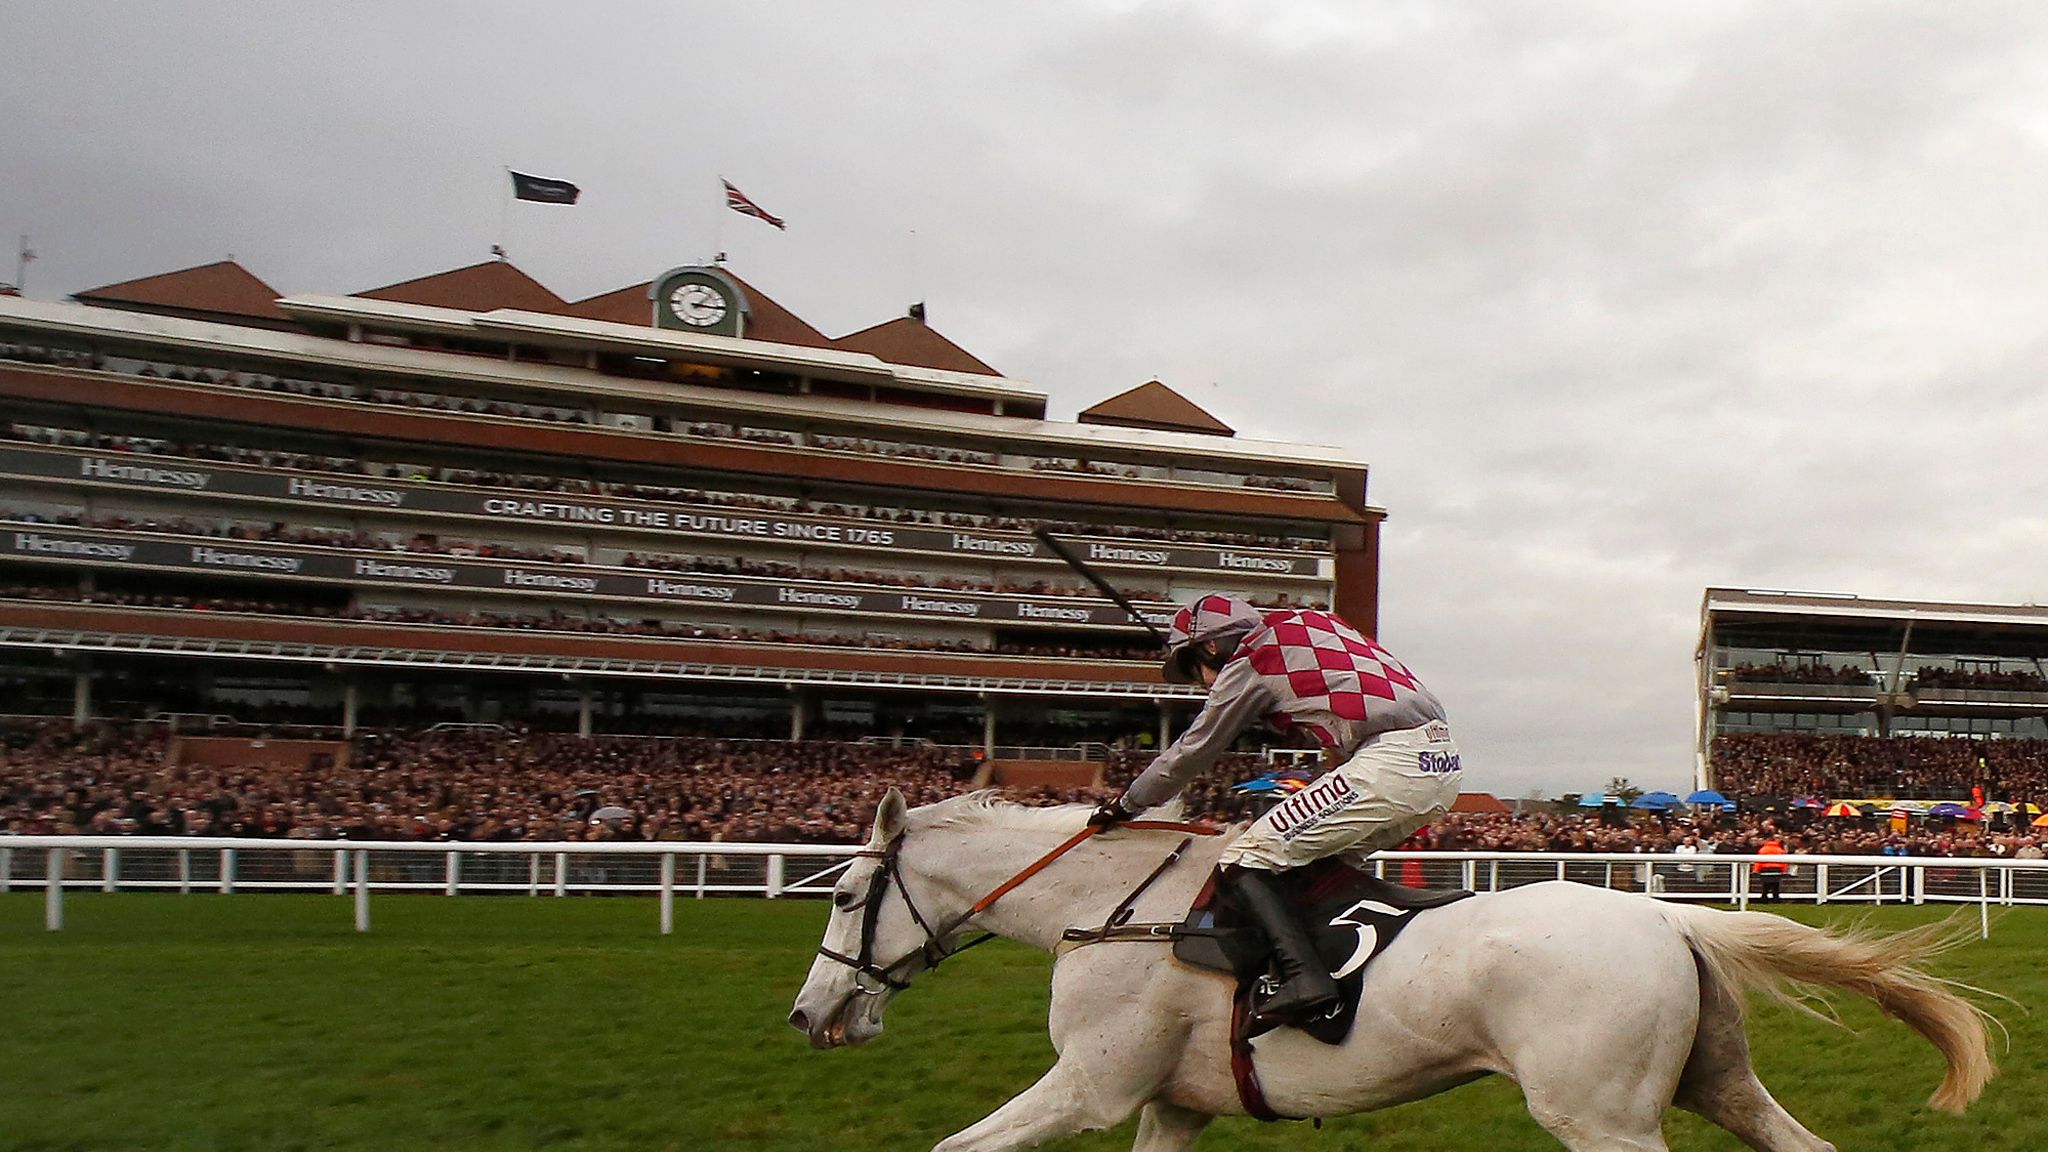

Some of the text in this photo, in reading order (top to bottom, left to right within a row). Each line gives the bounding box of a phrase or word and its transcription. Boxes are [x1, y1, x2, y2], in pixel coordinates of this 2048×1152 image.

[82, 458, 211, 490] Hennessy
[288, 478, 405, 507] Hennessy
[484, 499, 894, 545] CRAFTING THE FUTURE SINCE 1765
[15, 533, 135, 561] Hennessy
[953, 534, 1038, 557] Hennessy
[1090, 543, 1170, 566] Hennessy
[192, 547, 302, 573] Hennessy
[355, 559, 456, 583] Hennessy
[1219, 552, 1296, 574] Hennessy
[504, 569, 598, 592] Hennessy
[647, 579, 736, 601] Hennessy
[779, 588, 862, 610] Hennessy
[902, 595, 980, 617] Hennessy
[1018, 603, 1093, 623] Hennessy
[1269, 774, 1350, 832] ultima
